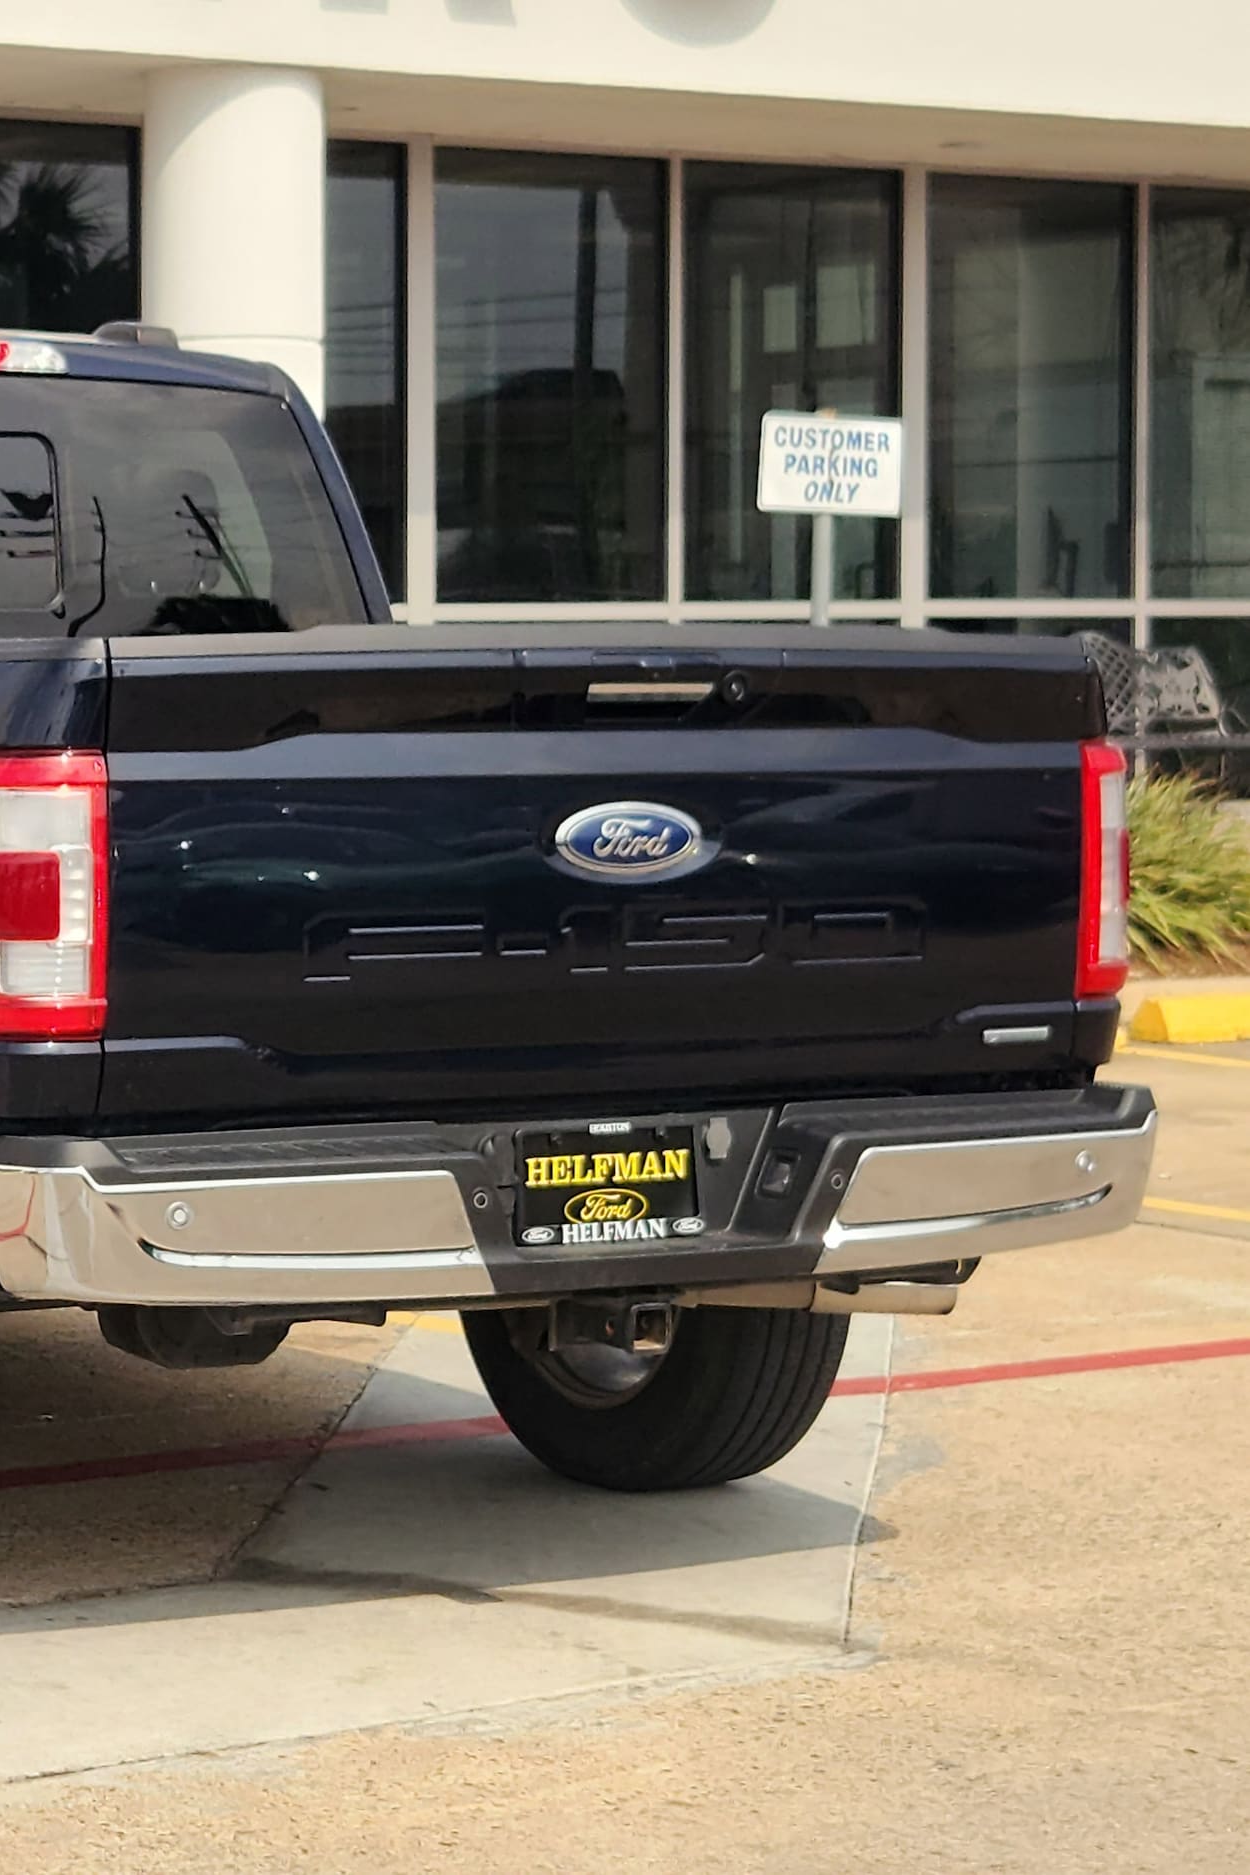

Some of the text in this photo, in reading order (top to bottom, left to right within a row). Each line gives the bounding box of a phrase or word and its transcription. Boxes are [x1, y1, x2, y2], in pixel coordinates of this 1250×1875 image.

[774, 425, 890, 452] CUSTOMER
[784, 454, 878, 478] PARKING
[804, 480, 860, 504] ONLY
[593, 818, 672, 858] Ford
[525, 1149, 690, 1188] HELFMAN
[580, 1194, 632, 1221] Ford
[561, 1218, 669, 1244] HELFMAN
